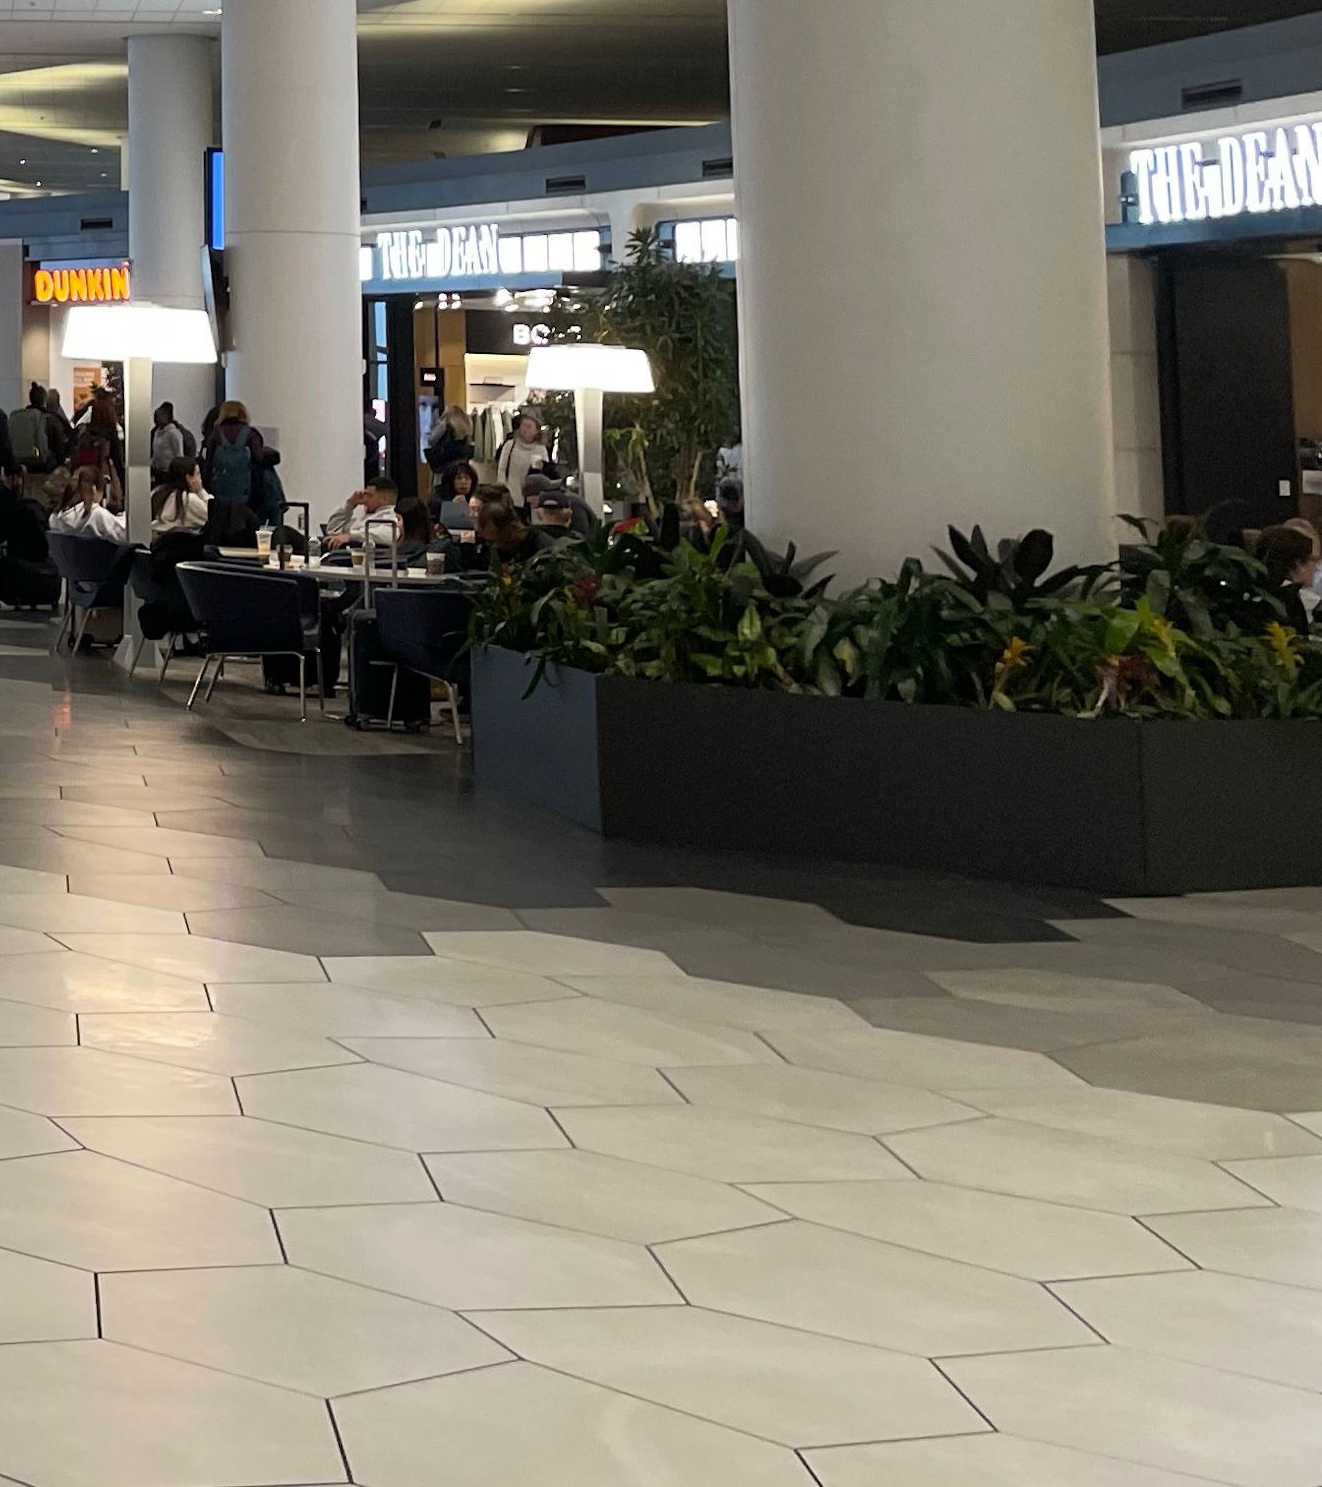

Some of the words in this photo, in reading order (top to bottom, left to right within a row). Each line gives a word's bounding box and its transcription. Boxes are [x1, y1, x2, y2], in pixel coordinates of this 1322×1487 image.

[1129, 141, 1207, 225] THE
[377, 230, 423, 280] THE
[435, 223, 499, 277] DEAN
